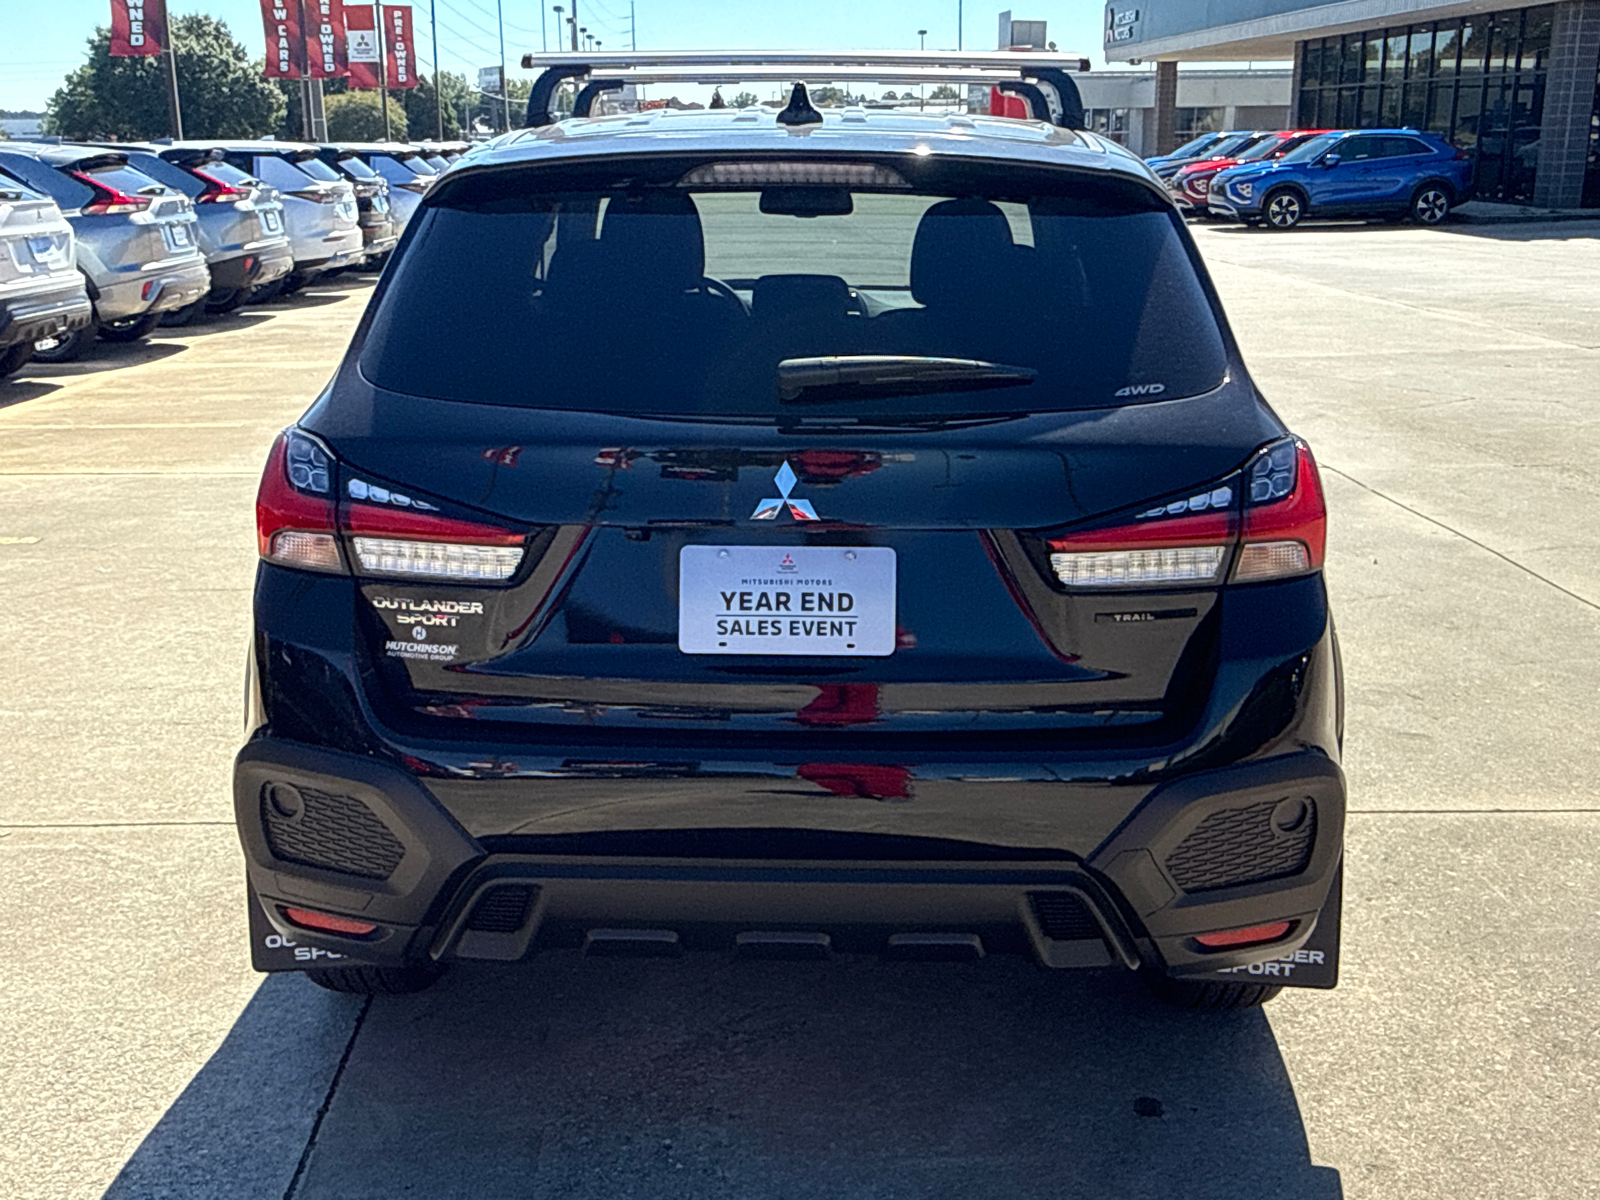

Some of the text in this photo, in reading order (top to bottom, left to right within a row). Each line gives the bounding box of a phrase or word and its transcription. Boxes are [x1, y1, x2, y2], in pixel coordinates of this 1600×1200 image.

[278, 24, 289, 72] CARS
[393, 10, 407, 83] PRE-OWNED
[1114, 383, 1165, 397] 4WD
[741, 578, 793, 586] MITSUBISHI
[372, 596, 484, 614] OUTLANDER
[720, 591, 854, 612] YEAR END
[396, 612, 460, 627] SPORT
[1114, 613, 1155, 622] TRAIL
[717, 619, 857, 637] SALES EVENT
[385, 641, 457, 655] HUTCHINSON
[387, 651, 429, 660] AUTOMOTIVE
